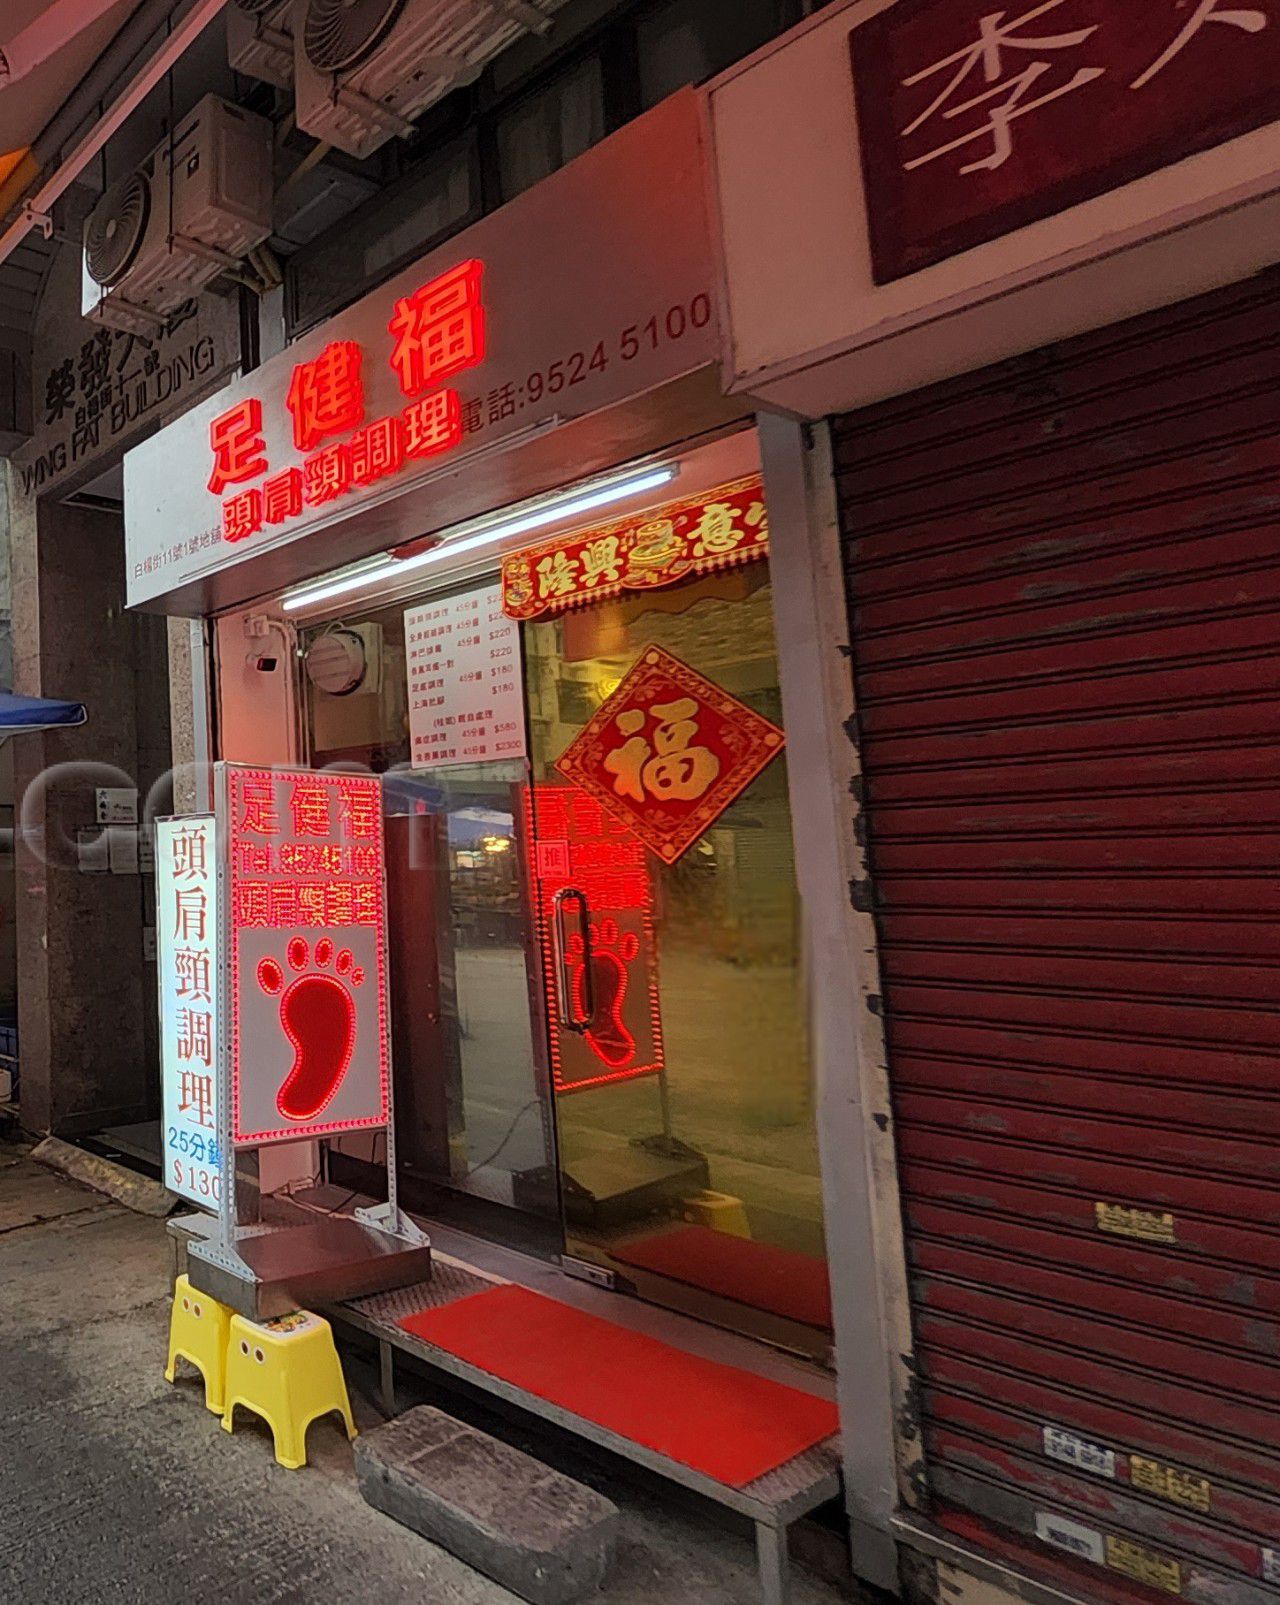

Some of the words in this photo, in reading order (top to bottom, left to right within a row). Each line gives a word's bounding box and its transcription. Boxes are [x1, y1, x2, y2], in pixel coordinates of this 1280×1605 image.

[208, 258, 484, 496] 足健福
[620, 293, 711, 360] 5100
[22, 443, 66, 494] WING
[73, 413, 104, 461] FAT
[112, 336, 214, 434] BUILDING
[223, 388, 462, 543] 頭肩頸調理
[489, 627, 511, 640] $220
[490, 646, 513, 659] $220
[603, 697, 720, 802] 福
[239, 780, 377, 840] 足健福
[170, 824, 216, 1130] 頭肩頸調理
